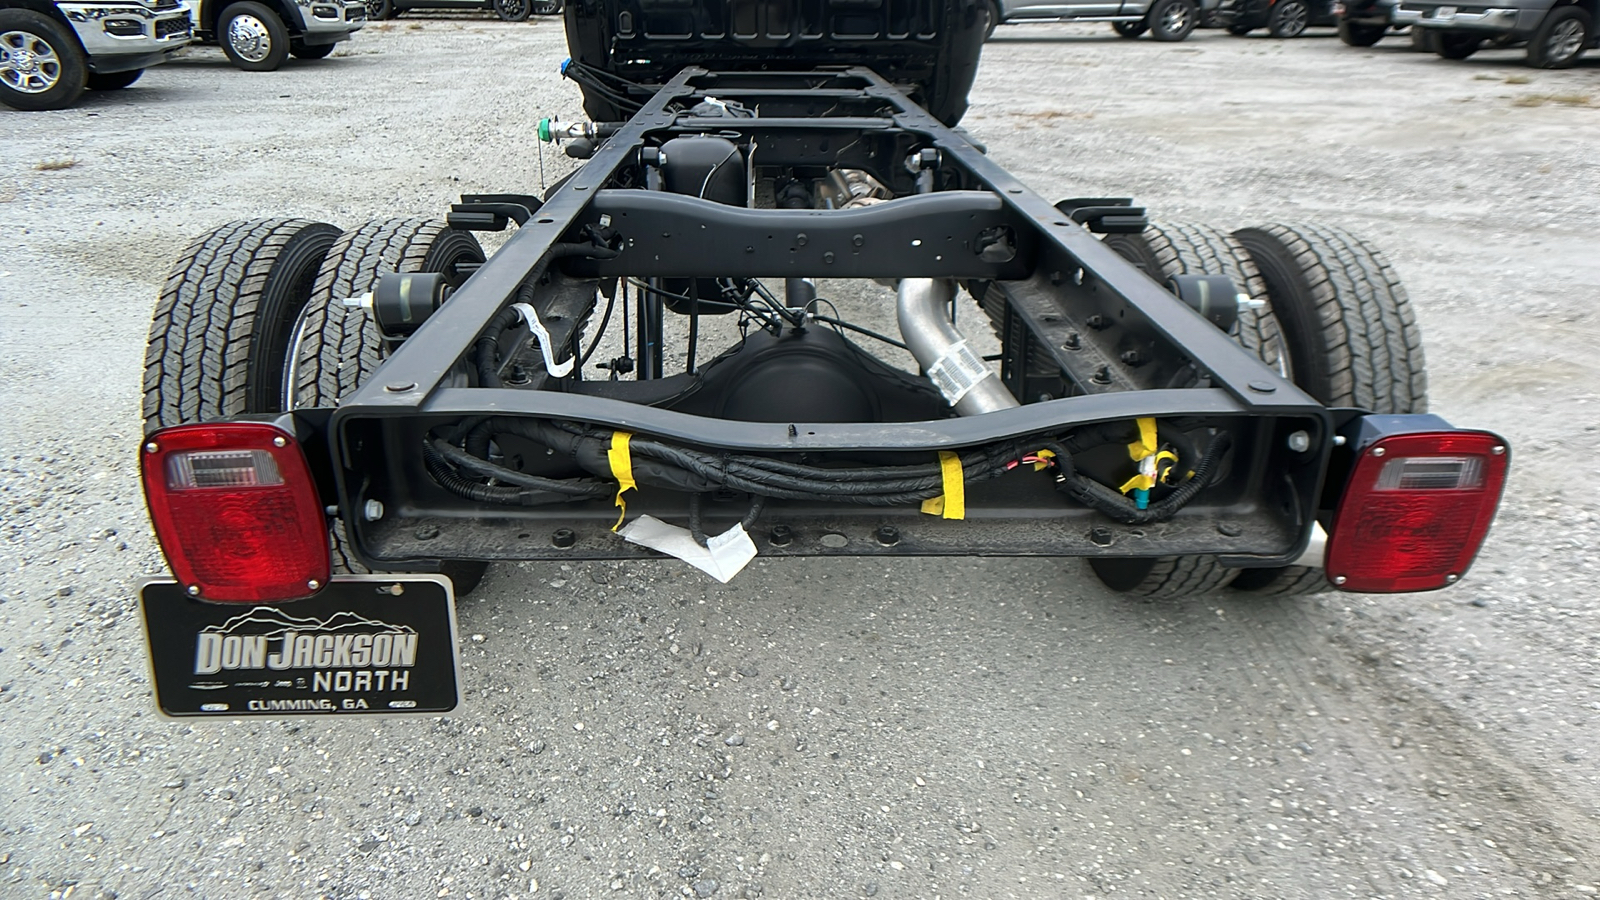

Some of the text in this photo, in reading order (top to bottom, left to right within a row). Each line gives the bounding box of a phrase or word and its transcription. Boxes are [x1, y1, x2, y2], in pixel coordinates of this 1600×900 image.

[194, 632, 418, 674] DON JACKSON
[312, 670, 410, 692] NORTH
[248, 699, 369, 711] CUMMING, GA
